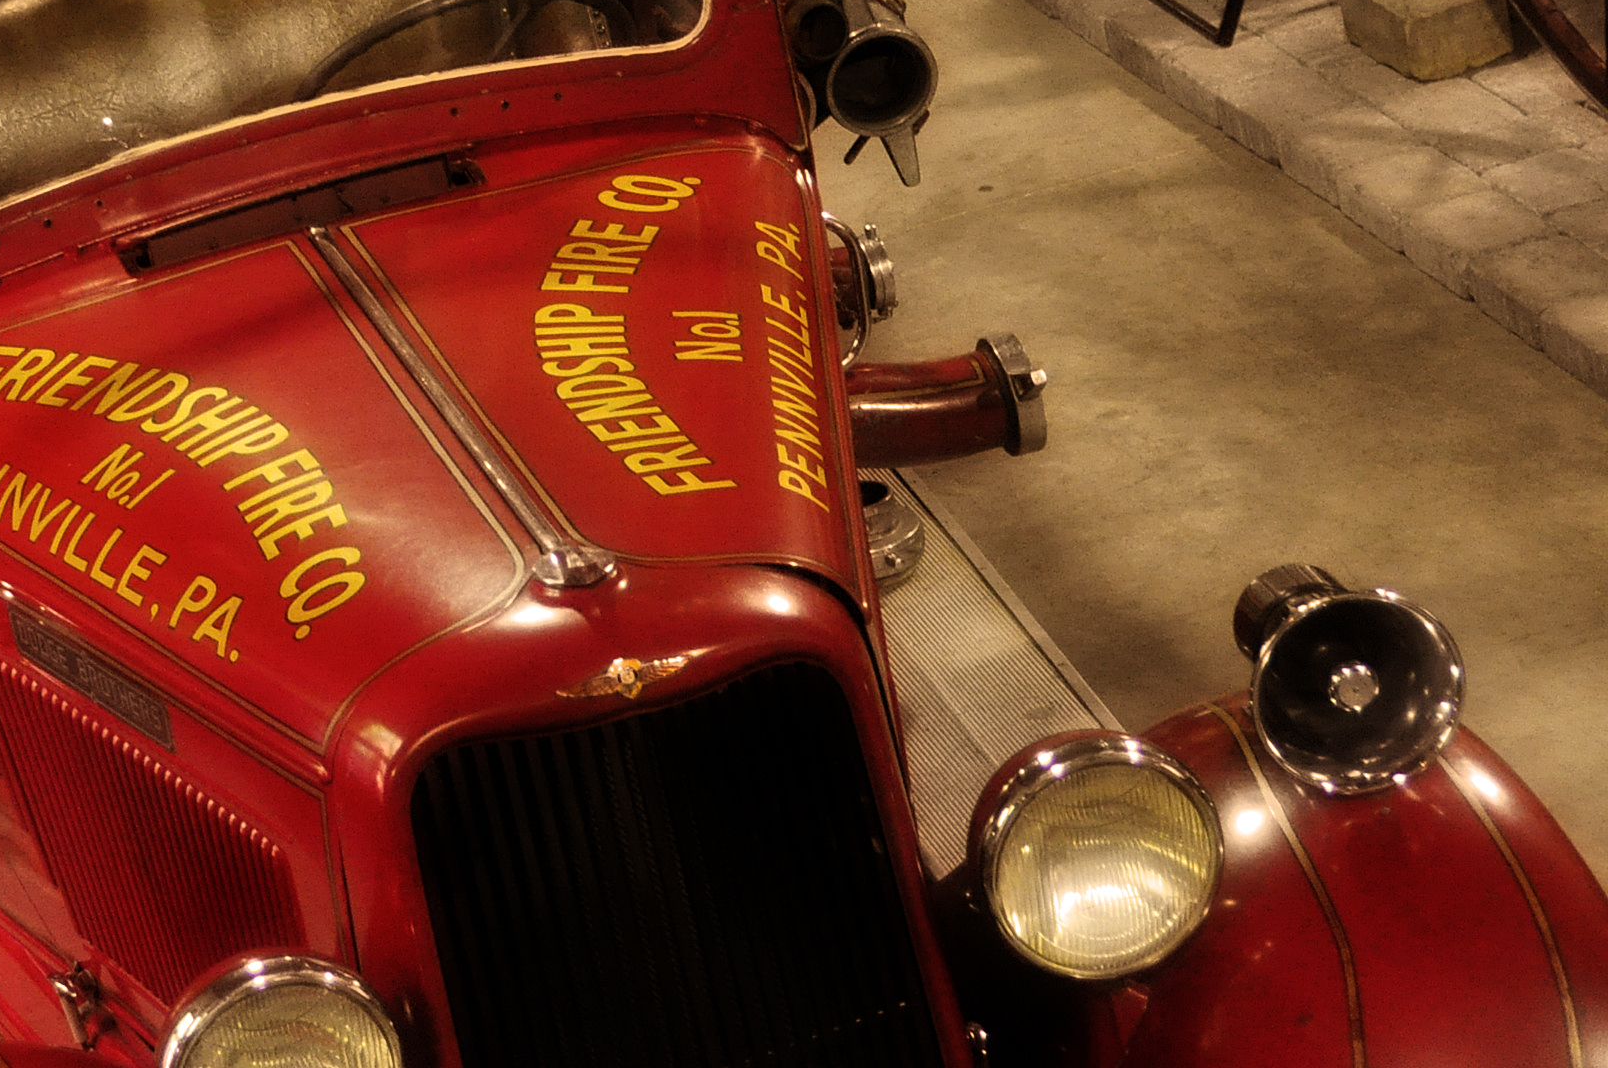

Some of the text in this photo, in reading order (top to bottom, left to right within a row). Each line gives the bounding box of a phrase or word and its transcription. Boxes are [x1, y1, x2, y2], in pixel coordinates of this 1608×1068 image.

[754, 220, 804, 282] PA.
[534, 174, 738, 496] FRIENDSHIP FIRE CO.
[223, 447, 348, 562] FIRE
[168, 575, 242, 663] PA.
[279, 546, 366, 641] CO.
